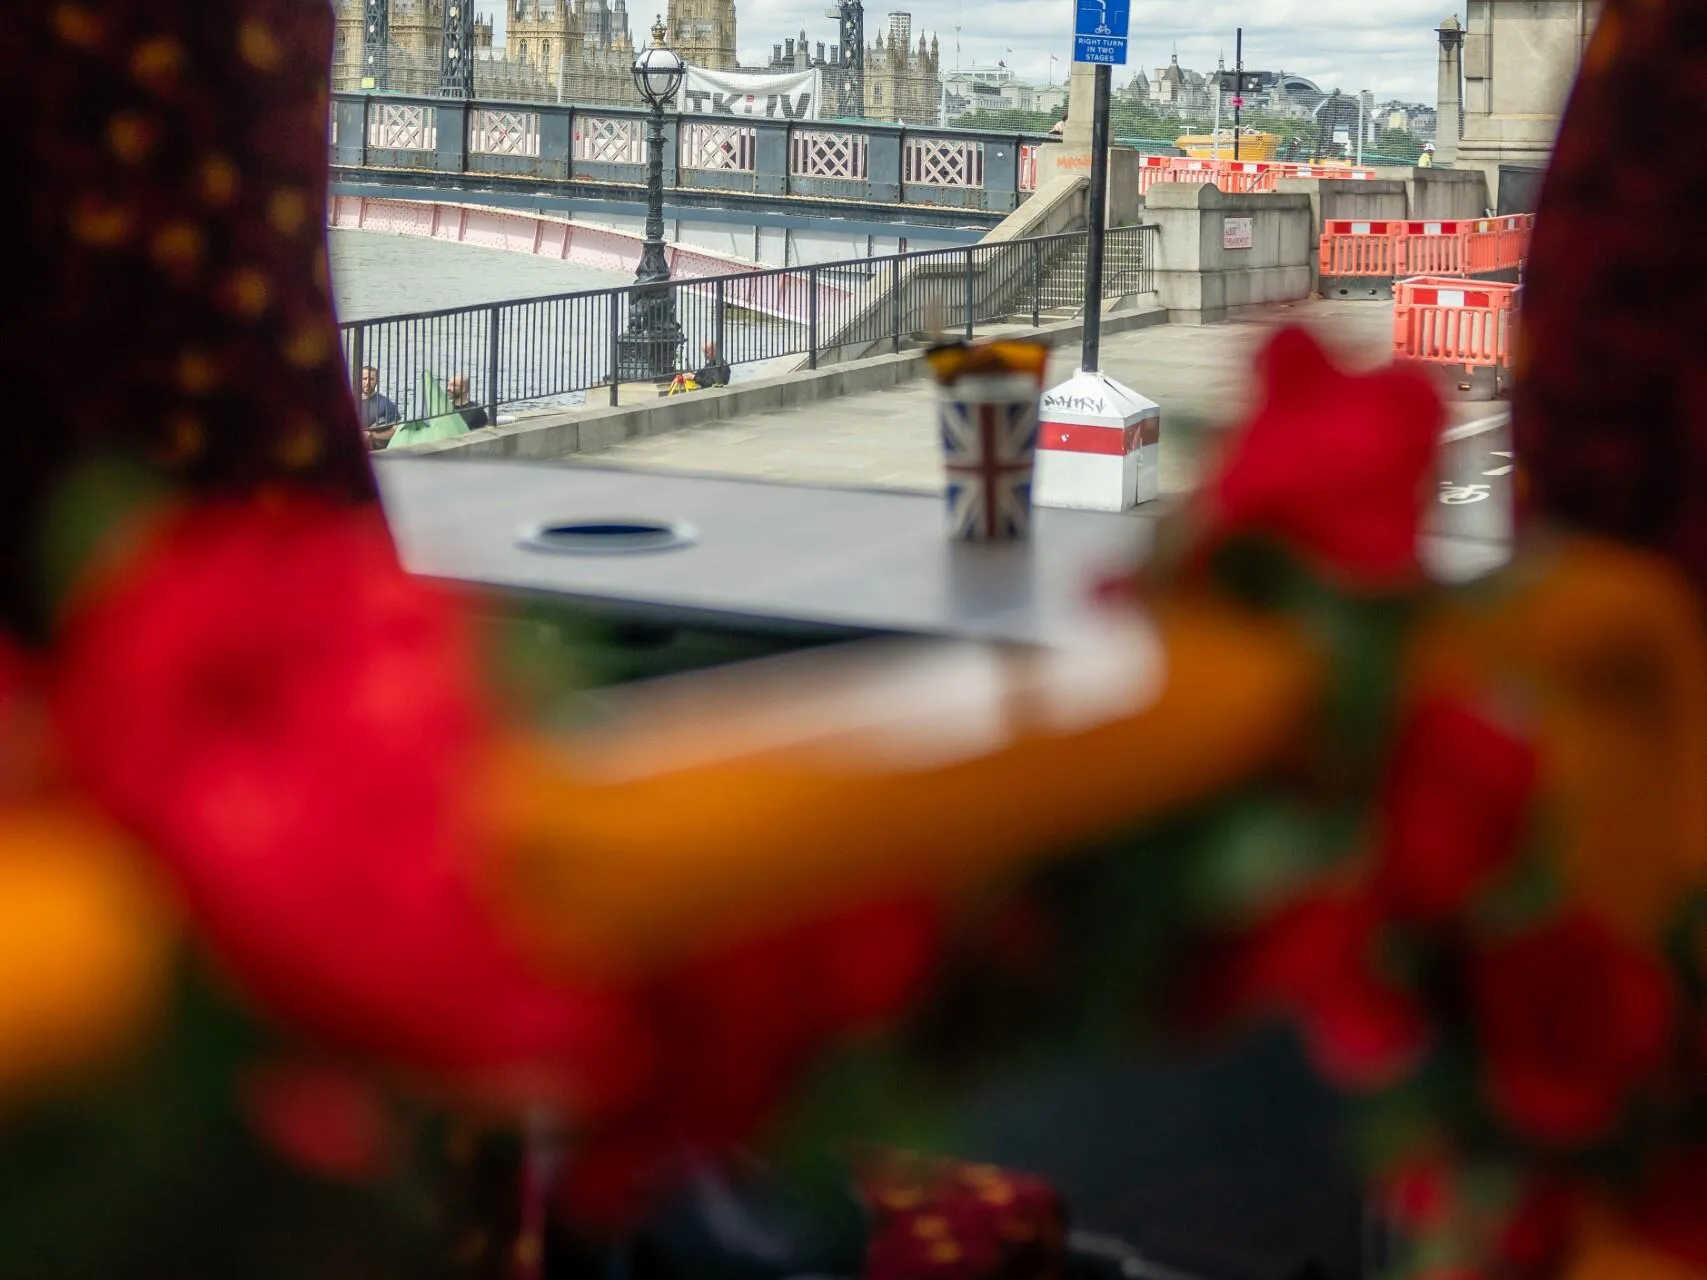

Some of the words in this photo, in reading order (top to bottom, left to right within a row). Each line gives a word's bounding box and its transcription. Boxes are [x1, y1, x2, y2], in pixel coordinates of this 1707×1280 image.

[1078, 37, 1101, 45] RIGHT
[1103, 39, 1124, 47] TURN
[1098, 46, 1115, 54] TWO
[1085, 53, 1115, 62] STAGES
